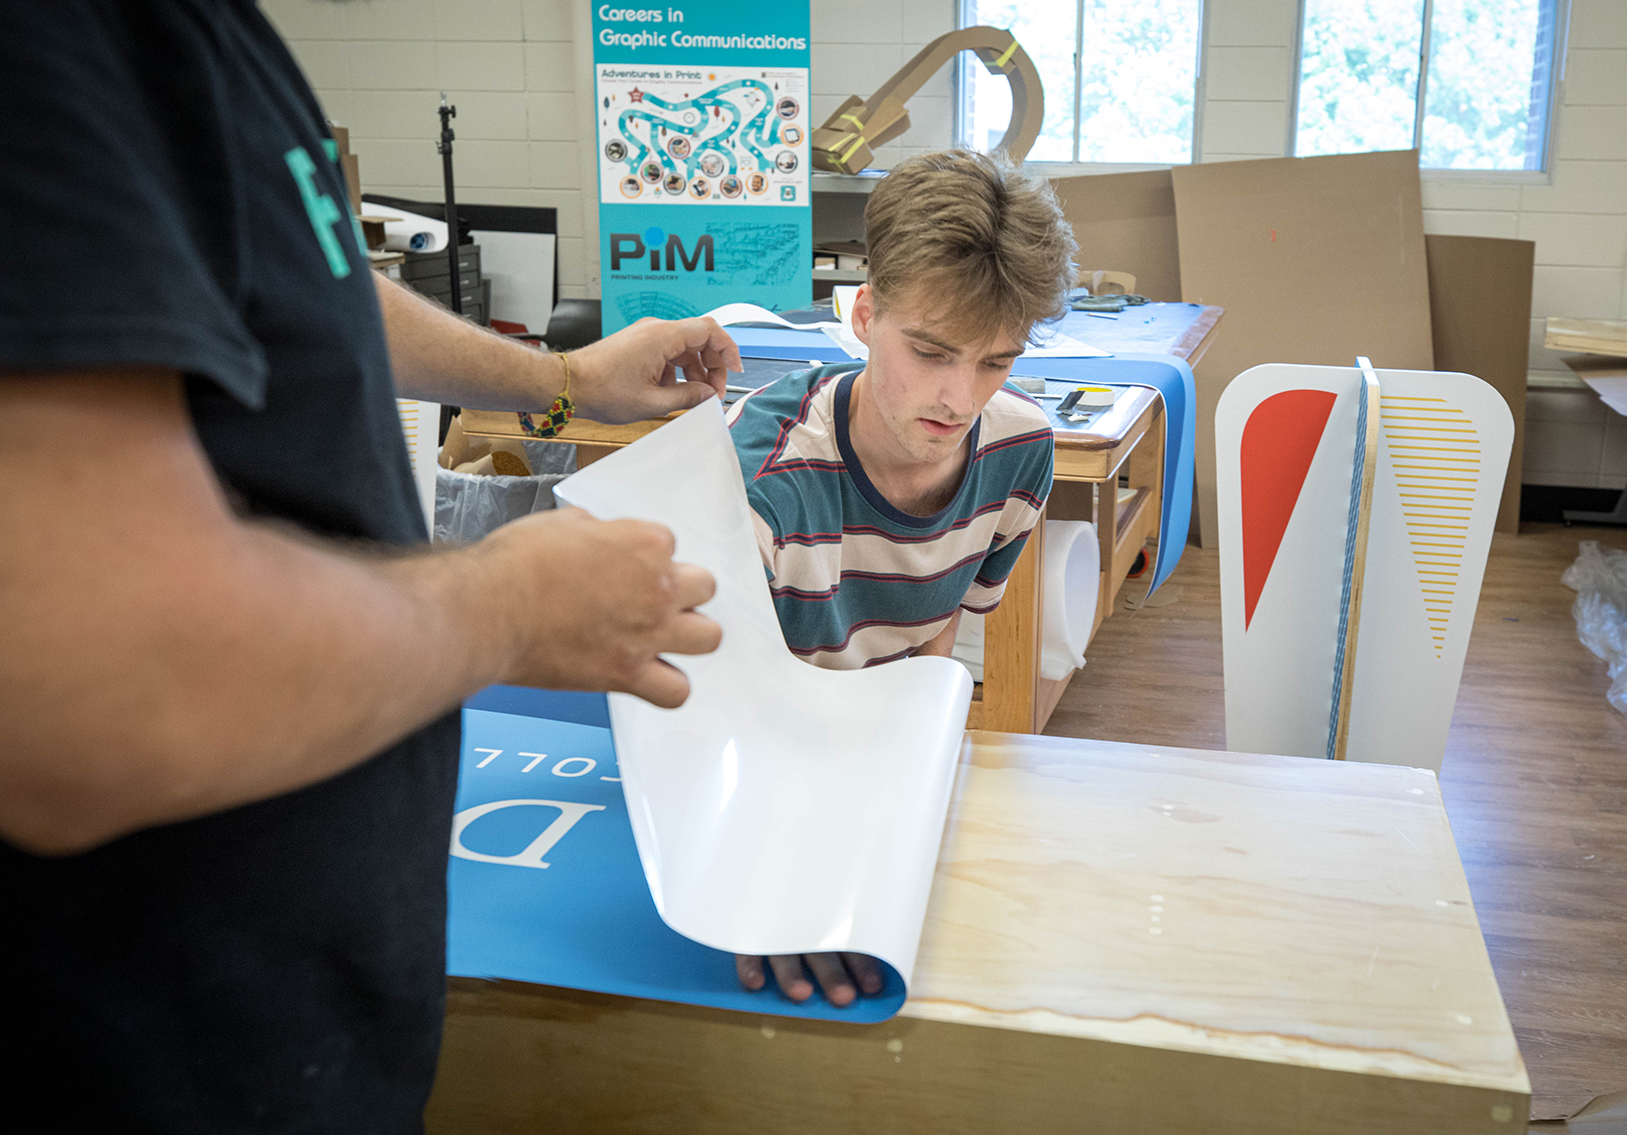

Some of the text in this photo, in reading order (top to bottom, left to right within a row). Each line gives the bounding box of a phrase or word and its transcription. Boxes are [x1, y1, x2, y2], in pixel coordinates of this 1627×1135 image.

[599, 5, 684, 23] Careers in
[599, 28, 807, 50] Graphic Communications
[602, 69, 702, 80] Adventures in Print
[285, 137, 369, 279] F
